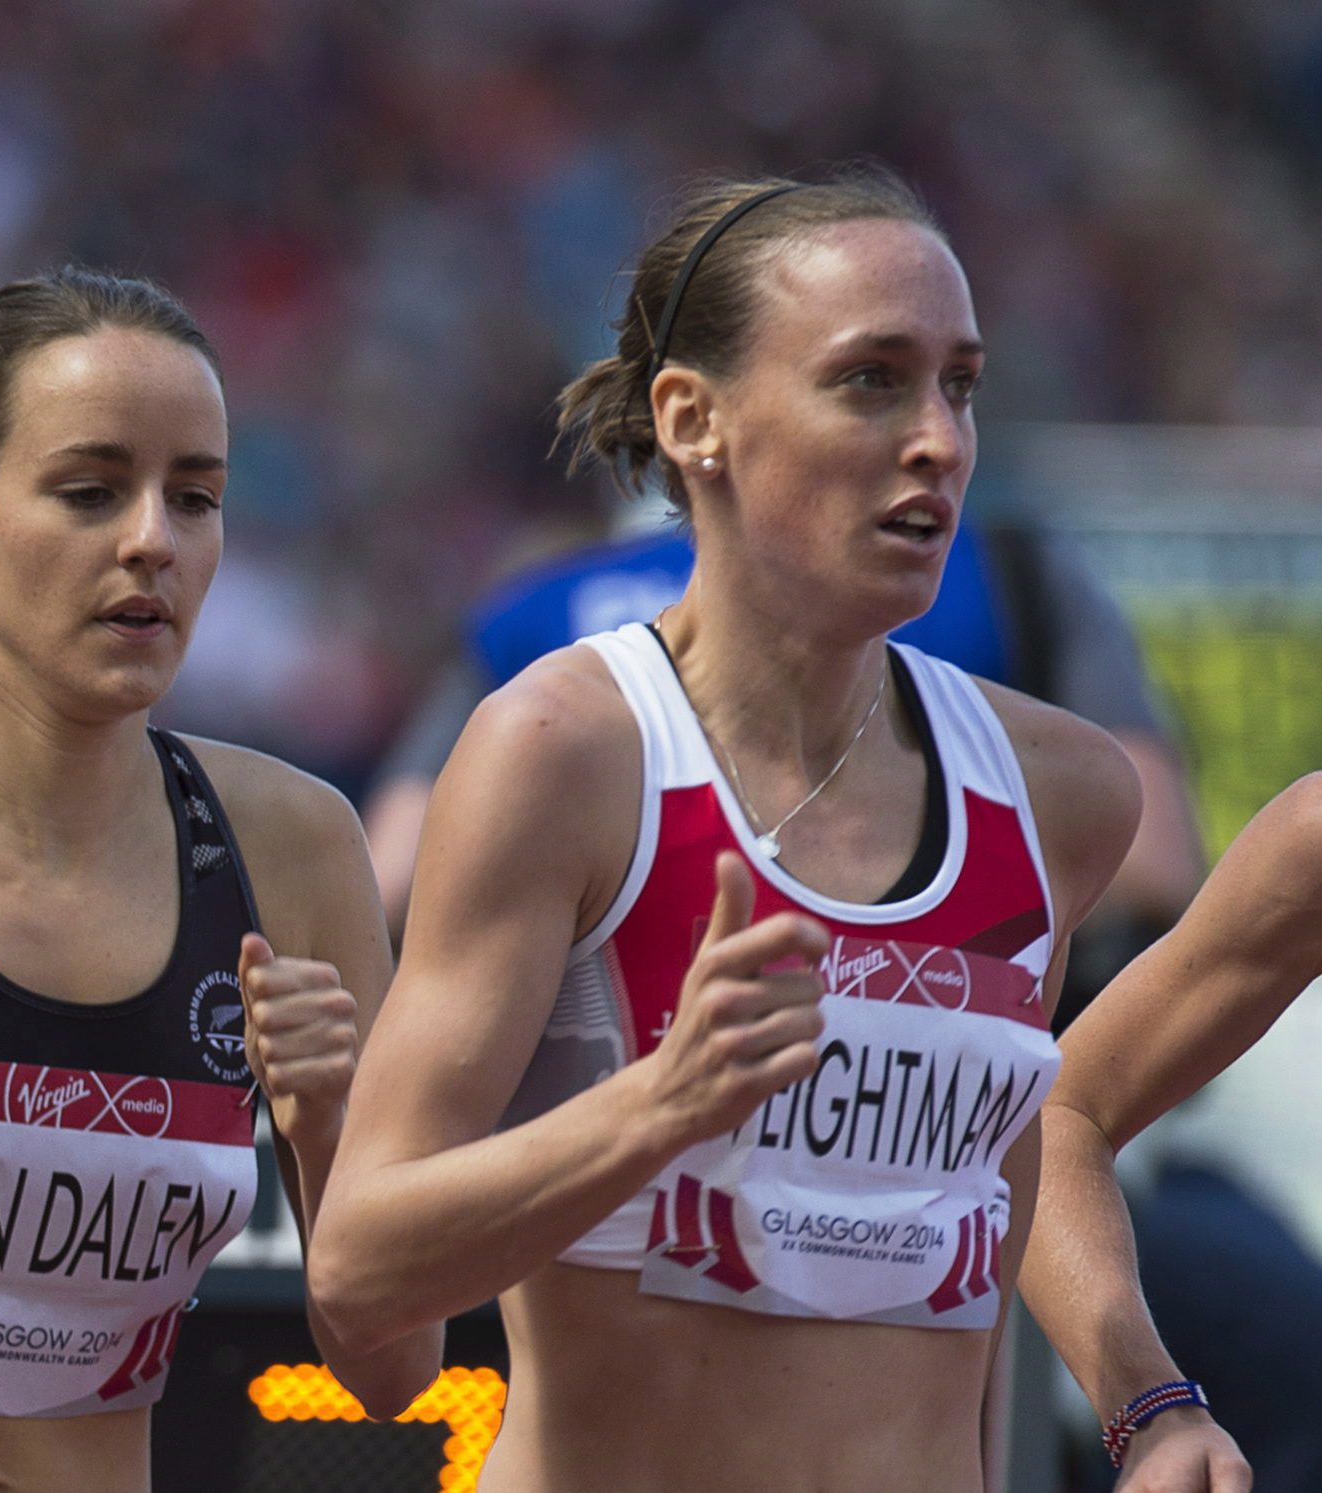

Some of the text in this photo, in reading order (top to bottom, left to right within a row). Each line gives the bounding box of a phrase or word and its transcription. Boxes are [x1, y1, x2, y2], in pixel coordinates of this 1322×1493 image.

[819, 936, 892, 999] Virgin
[189, 970, 243, 1042] COMMONWEALT
[18, 1066, 165, 1129] Virgin media
[733, 1038, 1040, 1173] EIGHTMAN
[28, 1171, 237, 1283] DALEN
[761, 1208, 946, 1250] GLASGOW 2014
[798, 1240, 890, 1262] COMMONWEALTH
[890, 1251, 927, 1265] GAMES
